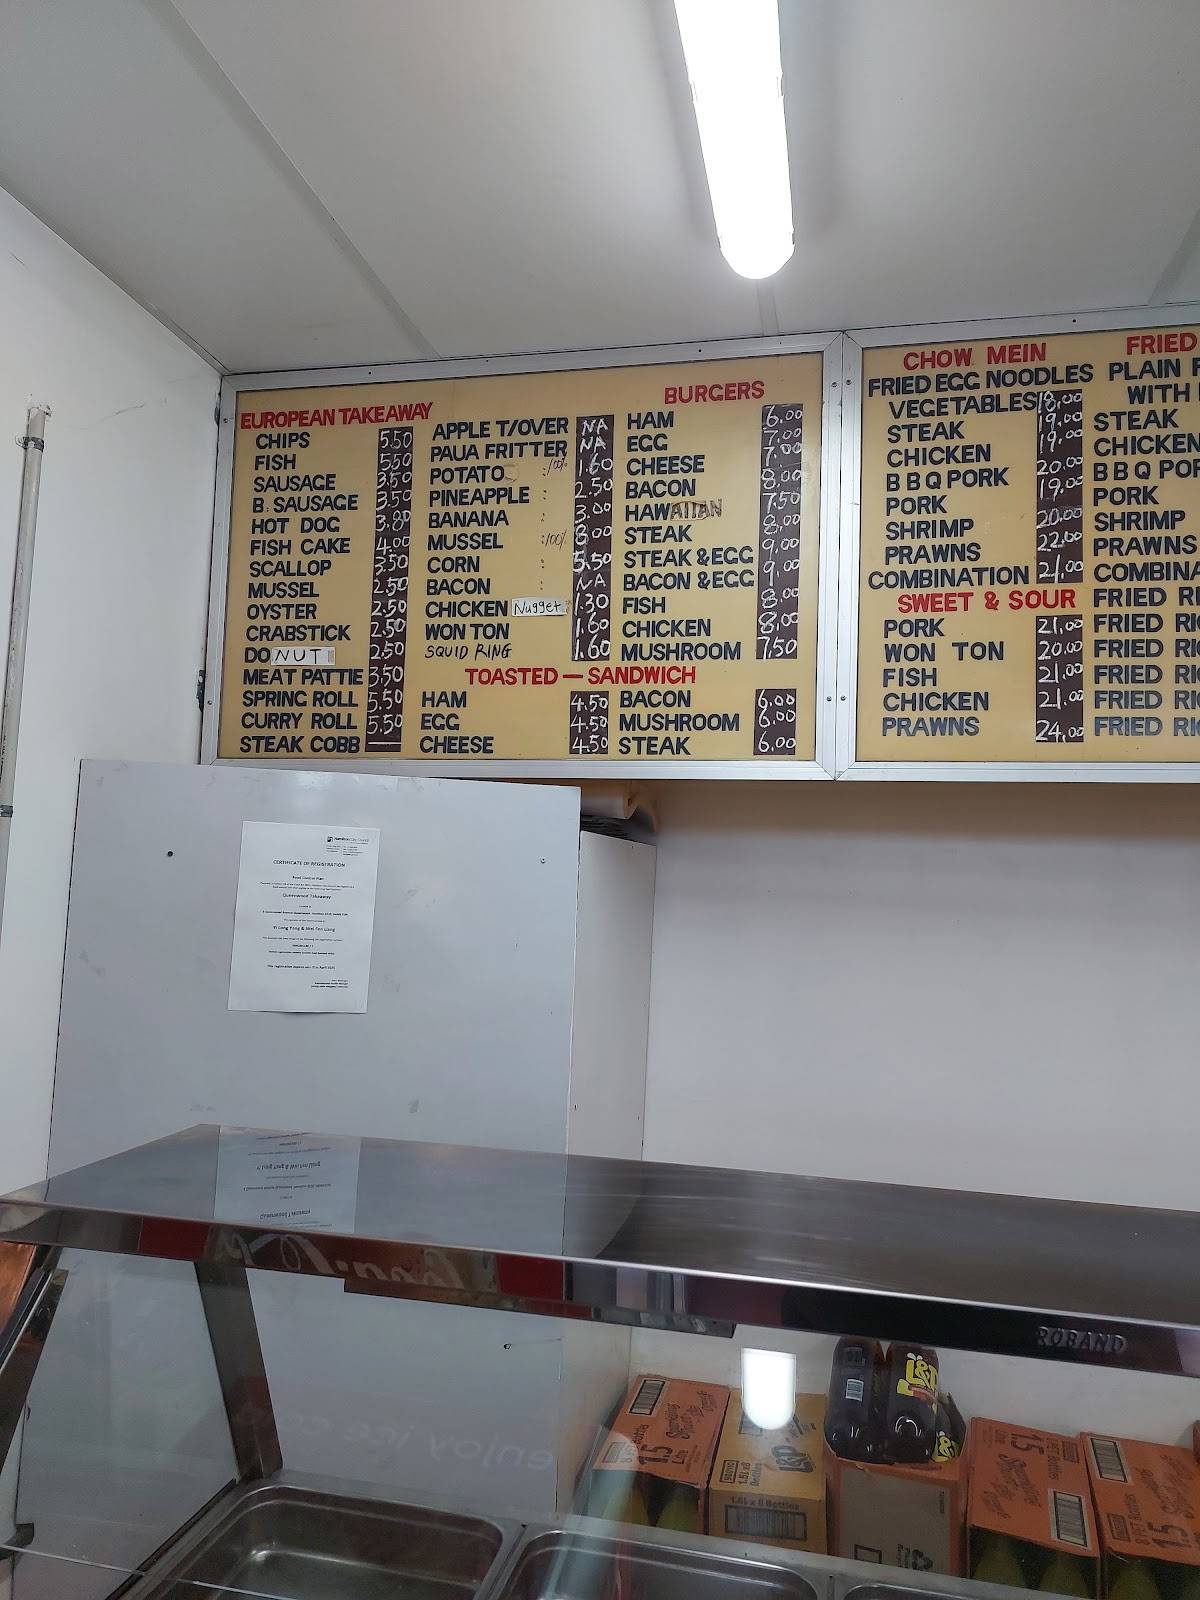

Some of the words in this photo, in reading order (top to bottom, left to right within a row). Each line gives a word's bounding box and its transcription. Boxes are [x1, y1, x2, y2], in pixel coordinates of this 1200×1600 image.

[1127, 333, 1198, 355] FRIED
[904, 348, 972, 370] CHOW
[988, 343, 1046, 364] MEIN
[1109, 359, 1180, 381] PLAIN
[868, 375, 931, 397] FRIED
[936, 372, 980, 392] EGG
[986, 364, 1093, 388] NOODLES
[664, 381, 765, 404] BURGERS
[1128, 383, 1190, 404] WITH
[889, 392, 1037, 419] VEGETABLES
[240, 409, 335, 429] EUROPEAN
[339, 402, 433, 425] TAKEAWAY
[627, 411, 674, 429] HAM
[1094, 408, 1178, 431] STEAK
[432, 421, 490, 440] APPLE
[496, 417, 568, 436] T/OVER
[888, 421, 964, 443] STEAK
[256, 432, 310, 449] CHIPS
[627, 434, 667, 452] EGG
[430, 444, 479, 462] PAUA
[485, 441, 567, 459] FRITTER
[887, 444, 990, 467] CHICKEN
[254, 454, 296, 470] FISH
[626, 455, 705, 475] CHEESE
[254, 474, 336, 492] SAUSAGE
[430, 465, 504, 484] POTATO
[948, 467, 1009, 488] PORK
[430, 487, 529, 507] PINEAPPLE
[626, 479, 696, 499] BACON
[1093, 486, 1159, 506] PORK
[274, 495, 358, 513] SAUSAGE
[886, 495, 947, 516] PORK
[251, 518, 289, 534] HOT
[301, 517, 340, 533] DOG
[429, 510, 509, 528] BANANA
[1094, 510, 1185, 531] SHRIMP
[625, 525, 692, 544] STEAK
[886, 519, 974, 540] SHRIMP
[250, 540, 291, 555] FISH
[301, 538, 350, 554] CAKE
[428, 533, 503, 551] MUSSEL
[1094, 535, 1197, 556] PRAWNS
[624, 549, 692, 568] STEAK
[712, 546, 753, 564] EGG
[885, 543, 981, 565] PRAWNS
[250, 560, 332, 577] SCALLOP
[428, 556, 479, 573] CORN
[427, 578, 490, 595] BACON
[623, 572, 690, 591] BACON
[712, 569, 754, 588] EGG
[868, 566, 1029, 589] COMBINATION
[248, 582, 319, 598] MUSSEL
[1094, 588, 1167, 607] FRIED
[426, 600, 508, 618] CHICKEN
[514, 601, 561, 615] Nugget
[622, 597, 665, 614] FISH
[898, 592, 973, 613] SWEET
[1009, 589, 1076, 610] SOUR
[247, 604, 317, 620] OYSTER
[426, 624, 465, 640] WON
[470, 623, 509, 639] TON
[622, 618, 711, 637] CHICKEN
[884, 618, 944, 638] PORK
[1094, 614, 1163, 632] FRIED
[246, 625, 351, 641] CRABSTICK
[425, 646, 468, 658] SQUID
[475, 643, 512, 659] RING
[621, 642, 741, 661] MUSHROOM
[885, 643, 935, 662] WON
[952, 642, 1004, 660] TON
[1094, 639, 1164, 658] FRIED
[243, 669, 297, 685] MEAT
[301, 669, 363, 685] PATTIE
[465, 668, 558, 685] TOASTED
[588, 666, 696, 685] SANDWICH
[883, 668, 937, 687] FISH
[1094, 665, 1163, 684] FRIED
[243, 691, 307, 707] SPRING
[312, 691, 358, 707] ROLL
[421, 691, 466, 708] HAM
[620, 690, 690, 708] BACON
[883, 692, 988, 711] CHICKEN
[1094, 690, 1162, 709] FRIED
[241, 713, 303, 729] CURRY
[311, 713, 357, 729] ROLL
[421, 714, 459, 730] EGG
[620, 714, 739, 731] MUSHROOM
[883, 717, 979, 736] PRAWNS
[1095, 716, 1163, 736] FRIED
[240, 736, 304, 753] STEAK
[310, 736, 360, 753] COBB
[420, 736, 494, 754] CHEESE
[619, 736, 691, 755] STEAK
[1039, 1326, 1128, 1352] ROBAND
